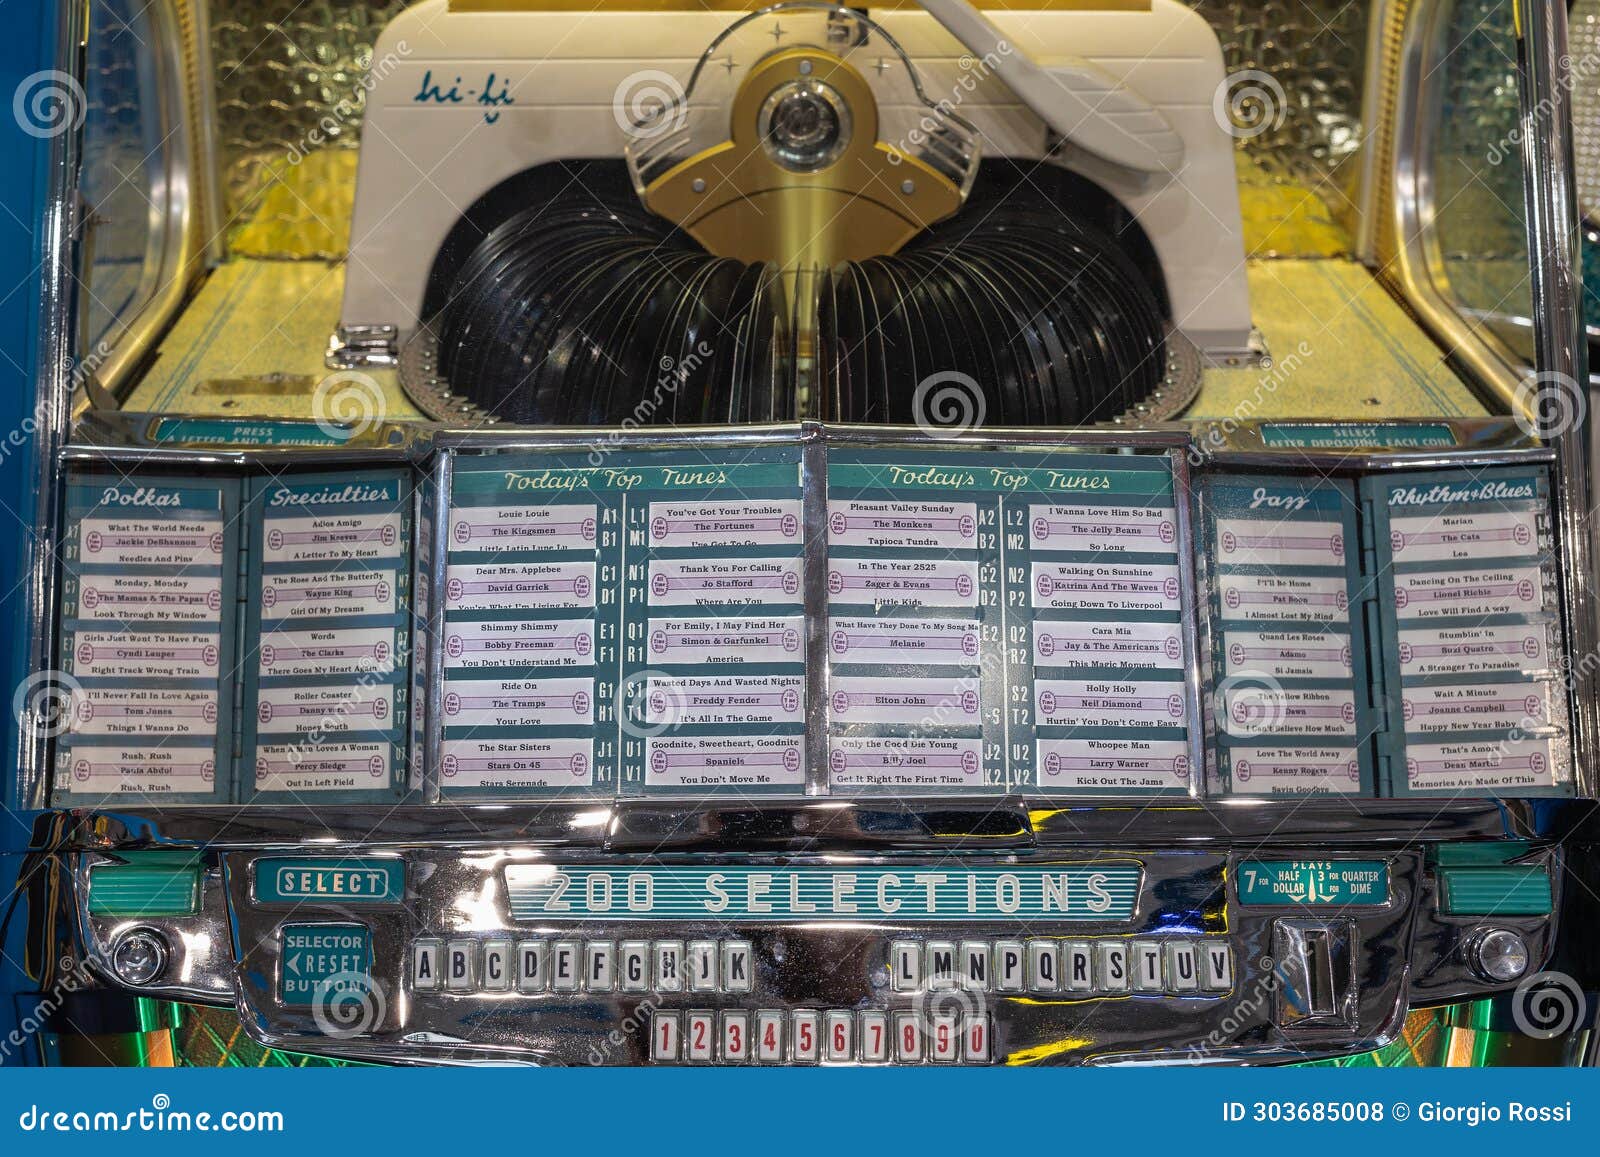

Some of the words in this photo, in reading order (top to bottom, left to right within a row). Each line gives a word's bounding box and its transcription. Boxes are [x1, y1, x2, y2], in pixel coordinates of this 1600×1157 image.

[414, 70, 514, 124] hi-fi
[233, 427, 274, 436] PRESS
[1334, 429, 1376, 437] SELECT
[505, 469, 588, 491] Today's
[604, 470, 642, 490] Top
[662, 469, 727, 485] Tunes
[890, 467, 975, 488] Today's
[990, 468, 1028, 490] Top
[1047, 471, 1110, 488] Tunes
[100, 488, 181, 507] Polkas
[270, 486, 389, 507] Specialties
[602, 509, 617, 524] A1
[631, 508, 645, 523] L1
[979, 510, 994, 525] A2
[1008, 511, 1023, 525] L2
[511, 528, 556, 536] Kingsmen
[603, 532, 616, 547] B1
[1008, 534, 1024, 549] M2
[1059, 568, 1094, 576] Walking
[865, 581, 890, 589] Zager
[335, 590, 352, 598] King
[481, 624, 518, 632] Shimmy
[521, 623, 558, 631] Shimmy
[684, 622, 713, 631] Emily,
[723, 622, 742, 630] May
[723, 637, 769, 645] Garfunkel
[652, 741, 696, 749] Goodnite,
[699, 740, 754, 749] Sweetheart,
[1014, 770, 1030, 785] V2
[284, 873, 380, 892] SELECT
[1244, 871, 1257, 892] 7
[1278, 872, 1300, 881] HALF
[1318, 871, 1325, 881] 3
[1342, 872, 1378, 882] QUARTER
[1273, 884, 1305, 893] DOLLAR
[1350, 885, 1371, 894] DIME
[543, 874, 654, 911] 200
[704, 874, 1111, 913] SELECTIONS
[287, 936, 362, 948] SELECTOR
[306, 955, 360, 973] RESET
[419, 951, 431, 978] A
[453, 951, 466, 978] B
[489, 952, 500, 979] C
[525, 951, 537, 977] D
[559, 951, 570, 978] E
[594, 953, 605, 979] F
[629, 955, 641, 981] G
[663, 952, 676, 979] H
[701, 952, 708, 979] J
[732, 953, 745, 979] K
[903, 953, 912, 979] L
[935, 952, 950, 979] M
[970, 954, 984, 981] N
[1006, 952, 1017, 979] P
[1040, 953, 1054, 982] Q
[1073, 953, 1087, 980] R
[1111, 952, 1123, 979] S
[1145, 953, 1156, 979] T
[1178, 953, 1190, 979] U
[1212, 952, 1225, 979] V
[285, 980, 362, 992] BUTTON
[661, 1024, 669, 1051] 1
[694, 1021, 706, 1050] 2
[729, 1024, 741, 1052] 3
[764, 1024, 775, 1051] 4
[800, 1023, 811, 1051] 5
[834, 1024, 845, 1051] 6
[871, 1026, 882, 1053] 7
[904, 1025, 915, 1052] 8
[938, 1025, 948, 1052] 9
[971, 1025, 982, 1052] 0
